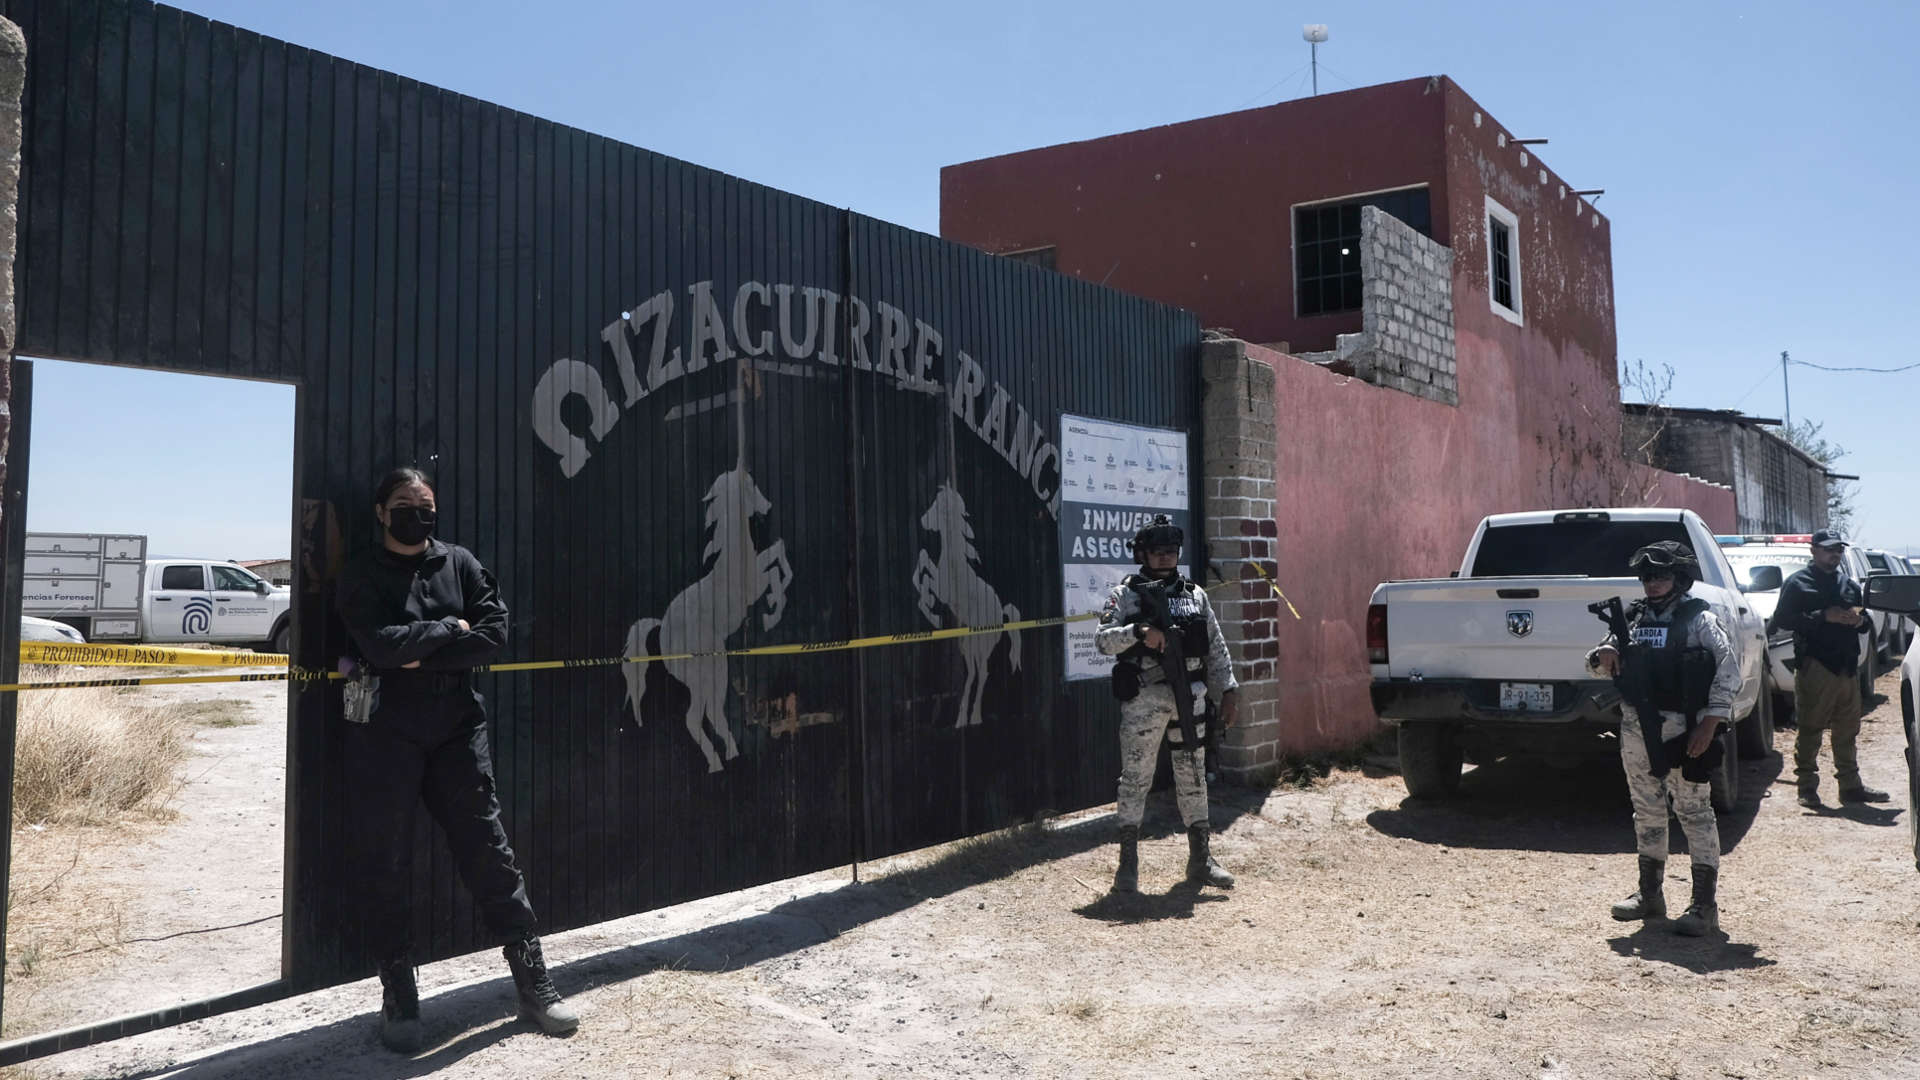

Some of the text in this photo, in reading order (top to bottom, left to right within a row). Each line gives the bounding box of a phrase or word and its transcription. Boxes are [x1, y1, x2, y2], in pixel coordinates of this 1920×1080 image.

[952, 350, 1060, 521] RANC
[1083, 509, 1173, 532] INMUEB
[22, 593, 94, 601] encias Forenses
[1637, 628, 1663, 638] ARDIA
[42, 646, 166, 664] PROHIBIDO EL PASO
